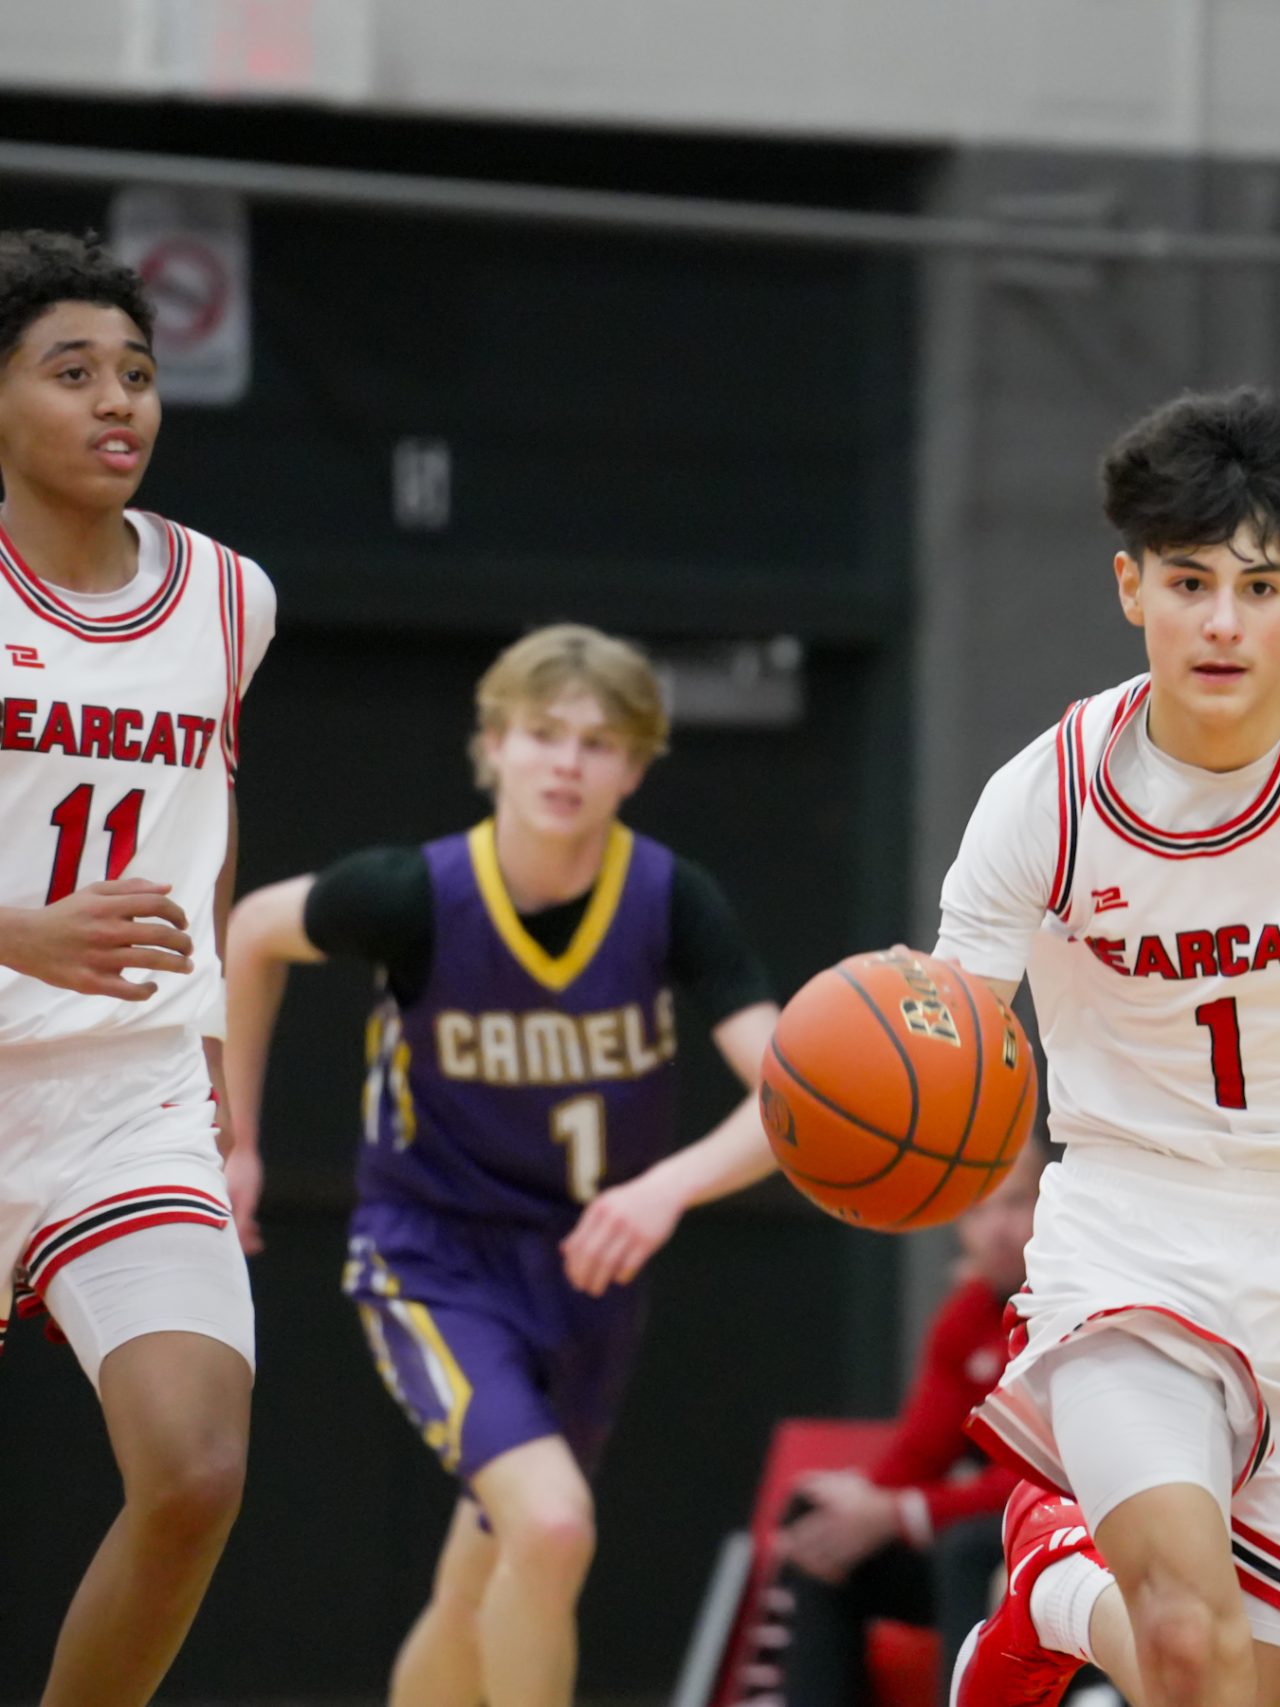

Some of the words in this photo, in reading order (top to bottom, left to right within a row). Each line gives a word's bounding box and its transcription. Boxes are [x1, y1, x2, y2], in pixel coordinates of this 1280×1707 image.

[0, 697, 216, 769] EARCAT
[44, 783, 145, 906] 11
[1195, 996, 1247, 1110] 1
[551, 1094, 607, 1203] 1
